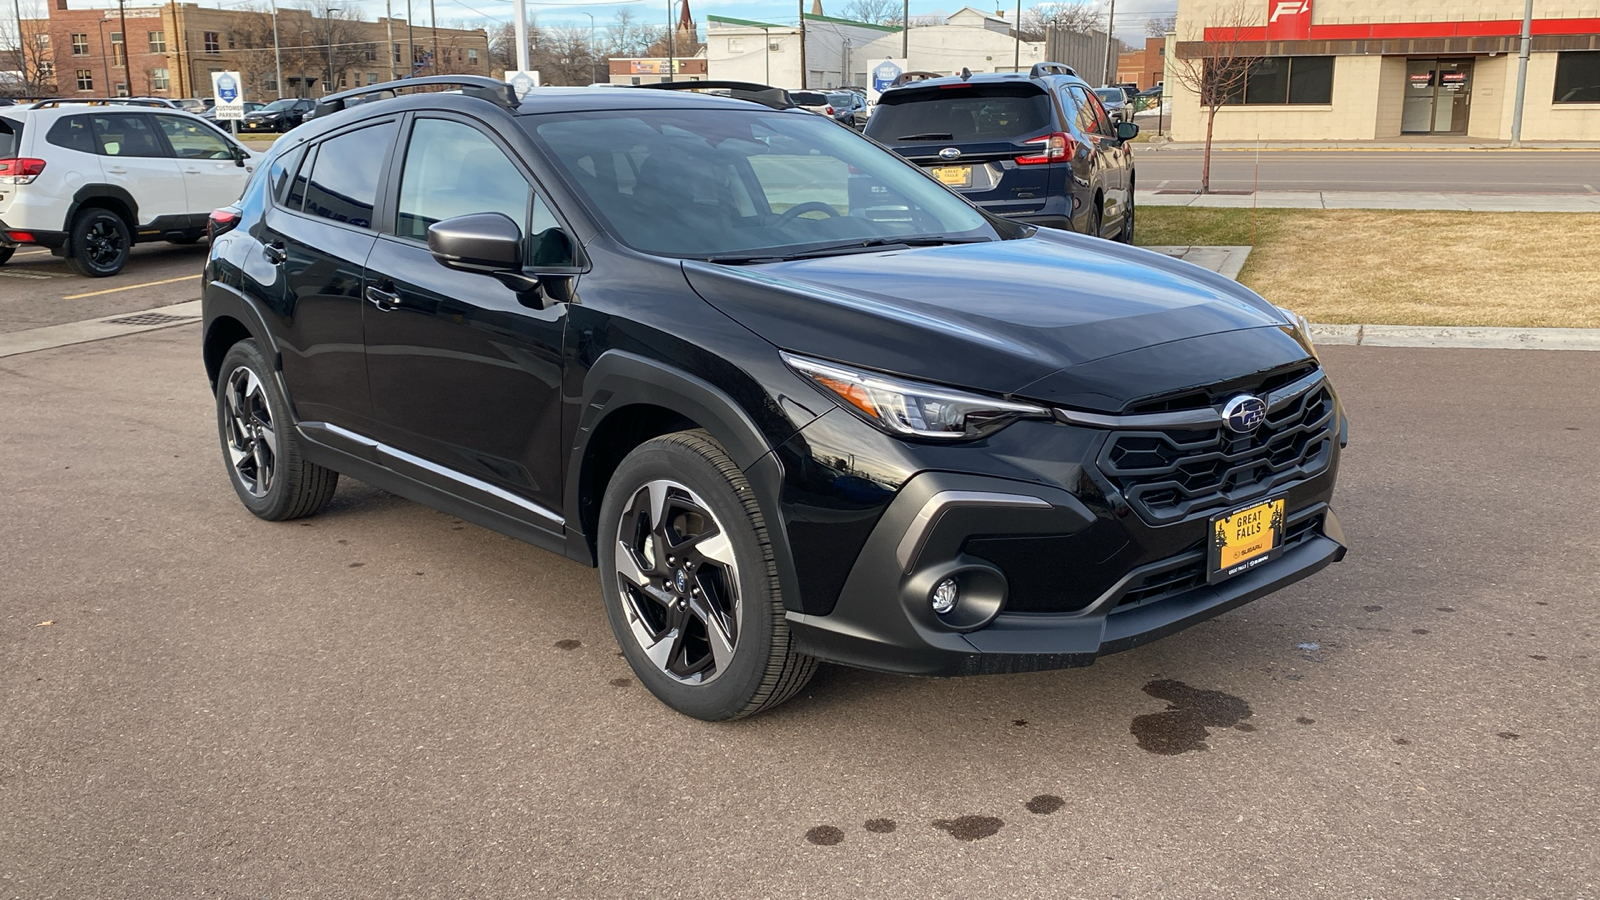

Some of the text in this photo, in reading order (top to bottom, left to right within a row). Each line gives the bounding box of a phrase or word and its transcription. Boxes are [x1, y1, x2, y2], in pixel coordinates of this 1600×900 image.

[1237, 511, 1262, 527] GREAT
[1236, 522, 1261, 540] FALLS
[1241, 543, 1262, 556] SUBARU
